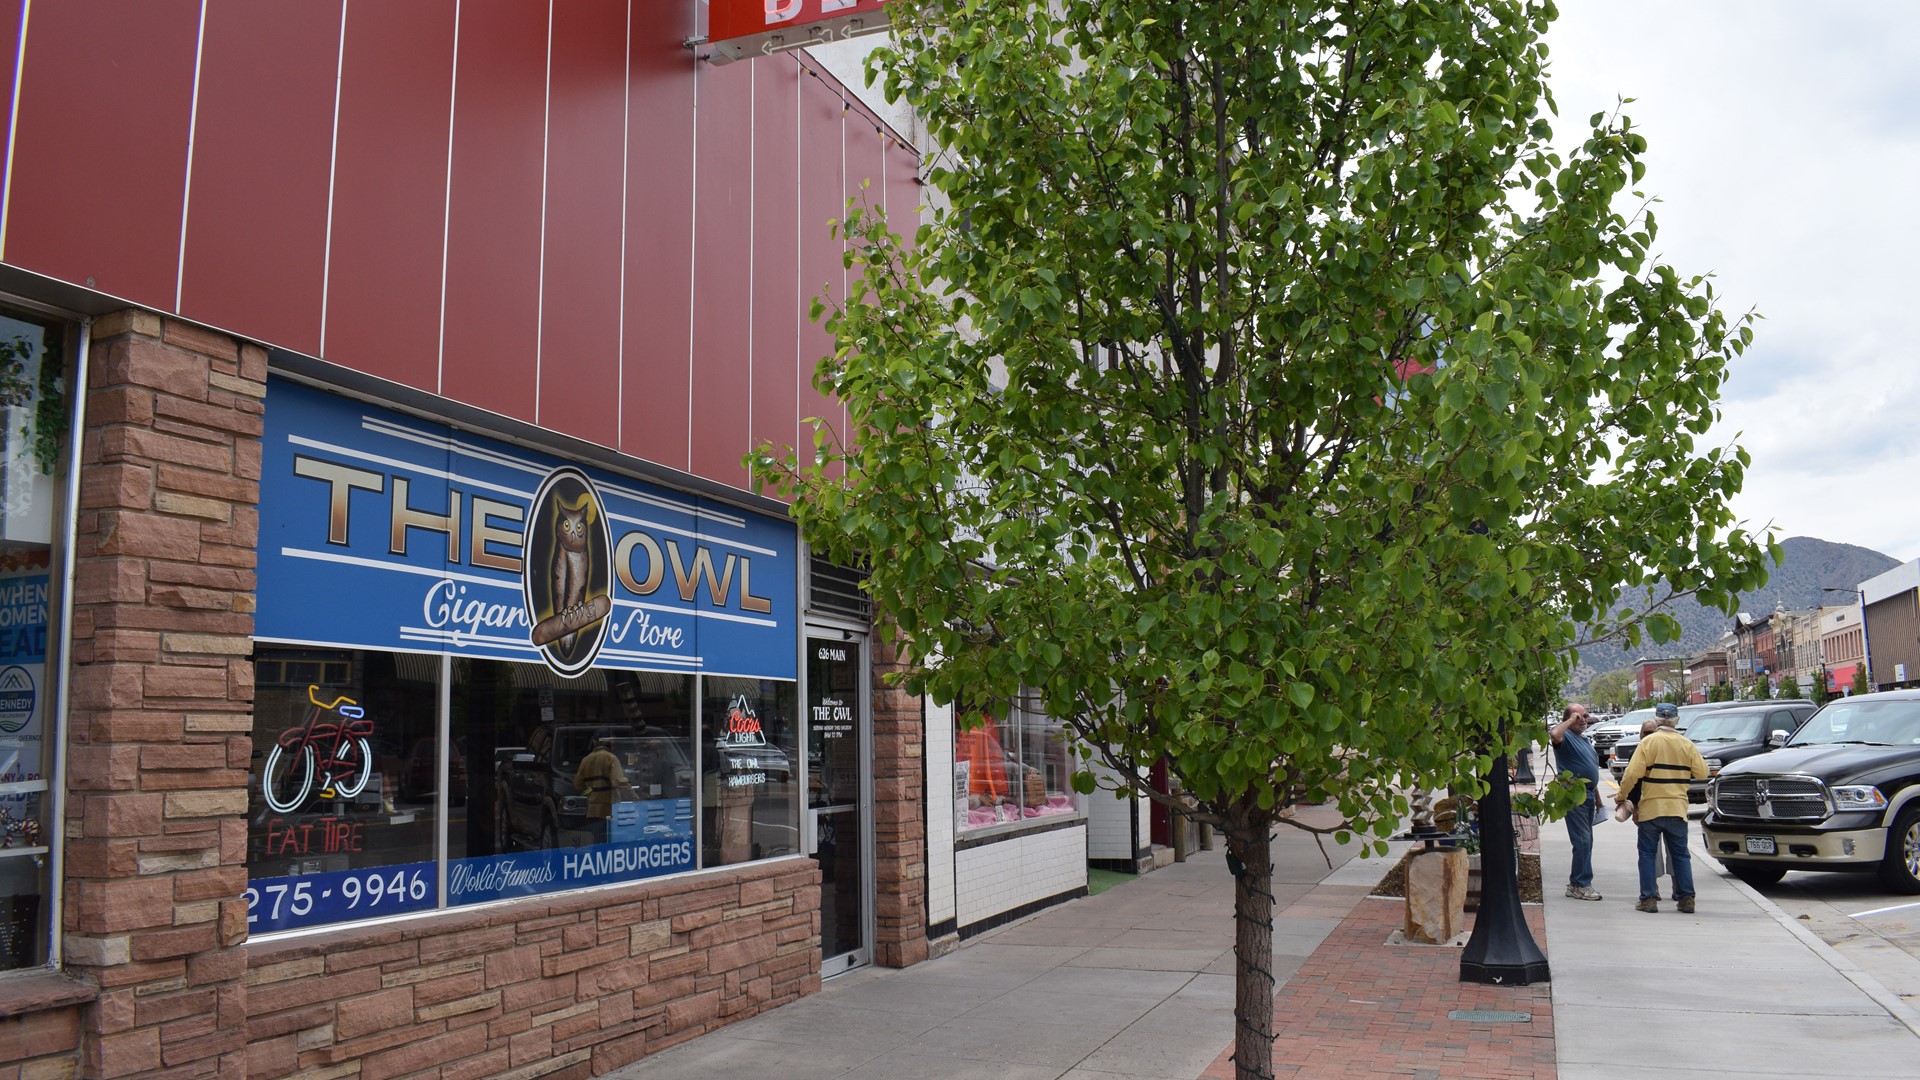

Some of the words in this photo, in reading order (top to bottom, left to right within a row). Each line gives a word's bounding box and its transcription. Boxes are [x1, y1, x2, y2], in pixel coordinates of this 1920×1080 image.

[293, 453, 524, 574] THE
[614, 530, 772, 615] OWL
[611, 608, 684, 649] Store
[818, 647, 830, 660] 626
[830, 648, 846, 661] MAIN
[729, 710, 761, 733] Coors
[813, 706, 830, 721] THE
[833, 706, 852, 721] OWL
[735, 732, 756, 743] LIGHT
[731, 758, 743, 769] THE
[728, 773, 766, 787] HAMBURGERS
[266, 818, 314, 856] FAT
[319, 817, 364, 852] TIRE
[450, 862, 501, 896] World
[496, 858, 557, 892] Famous
[563, 841, 691, 881] HAMBURGERS
